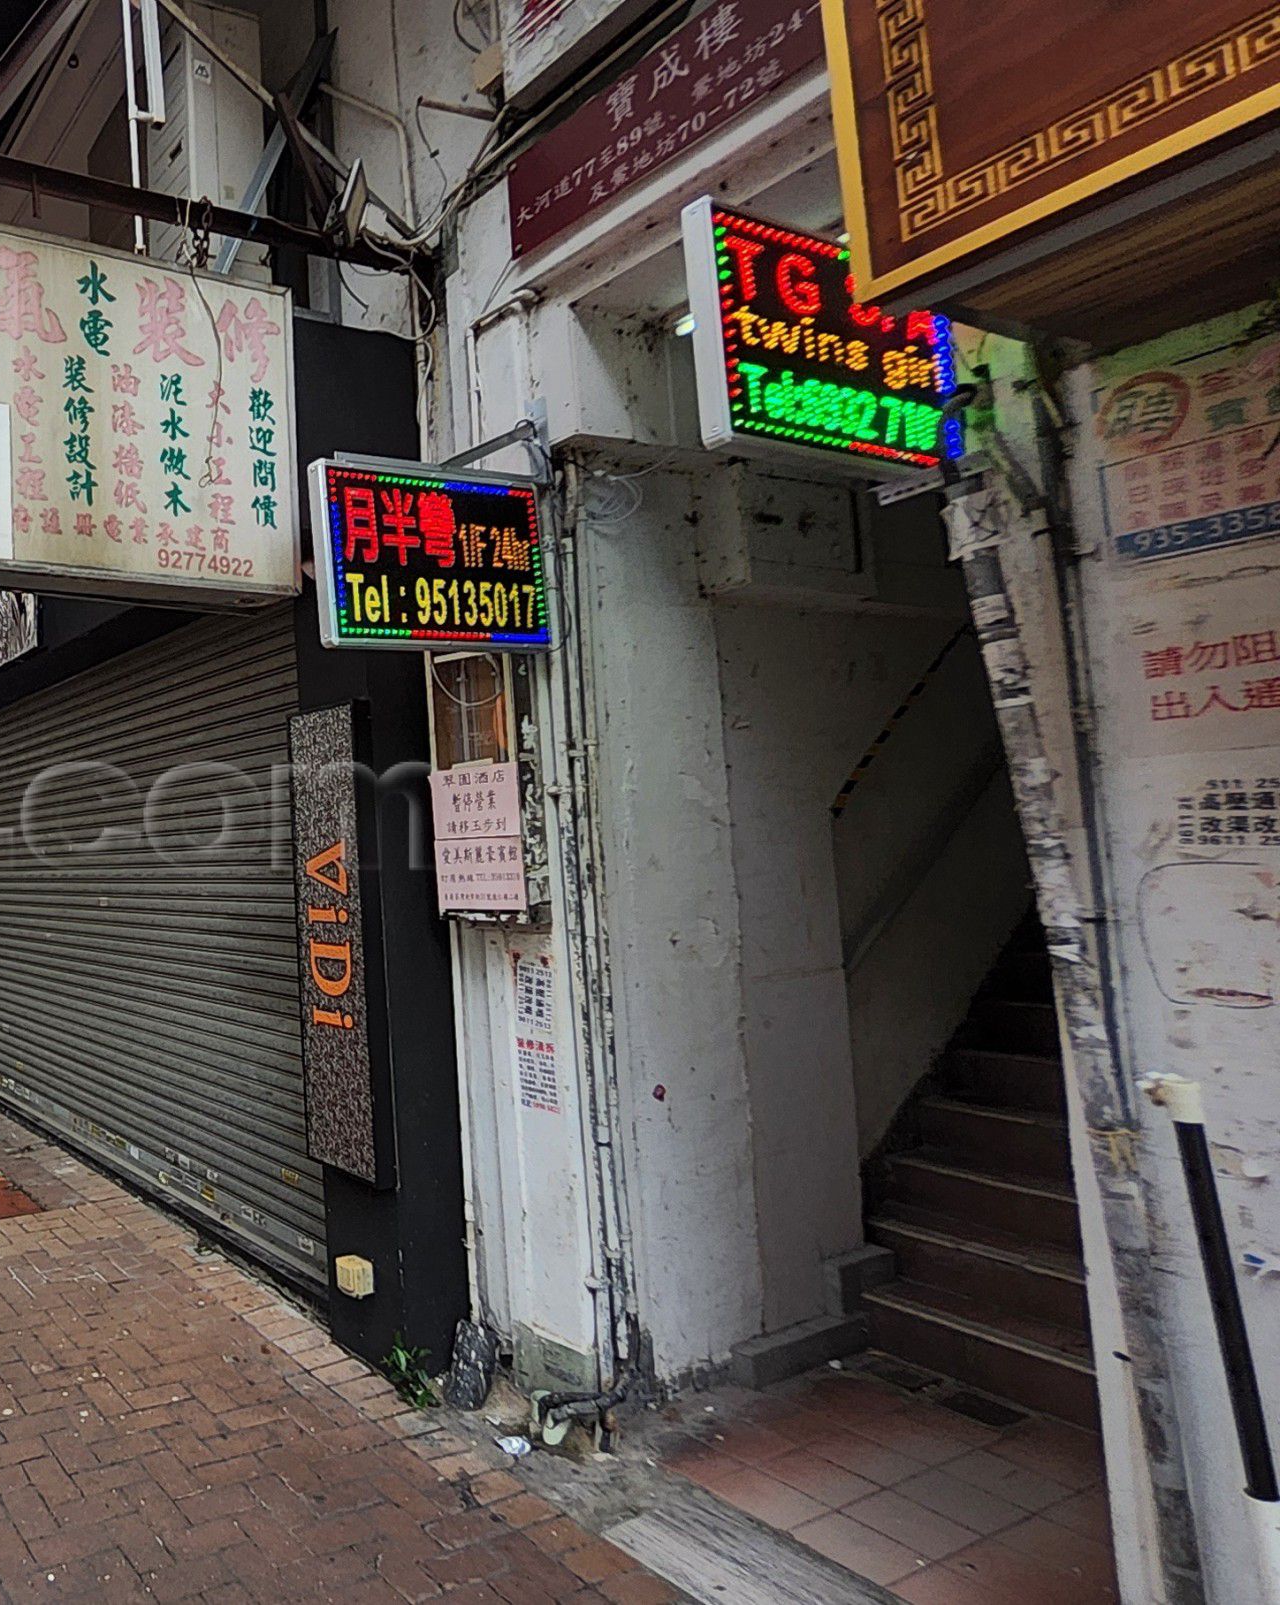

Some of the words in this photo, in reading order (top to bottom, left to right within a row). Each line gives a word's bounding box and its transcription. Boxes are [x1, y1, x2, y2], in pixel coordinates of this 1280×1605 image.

[76, 260, 116, 356] 水電
[132, 276, 280, 383] 裝修
[11, 346, 48, 502] 水電工程
[61, 355, 99, 507] 裝修設計
[156, 548, 255, 578] 92774922
[415, 577, 536, 628] 95135017
[451, 790, 497, 813] 暫停營業
